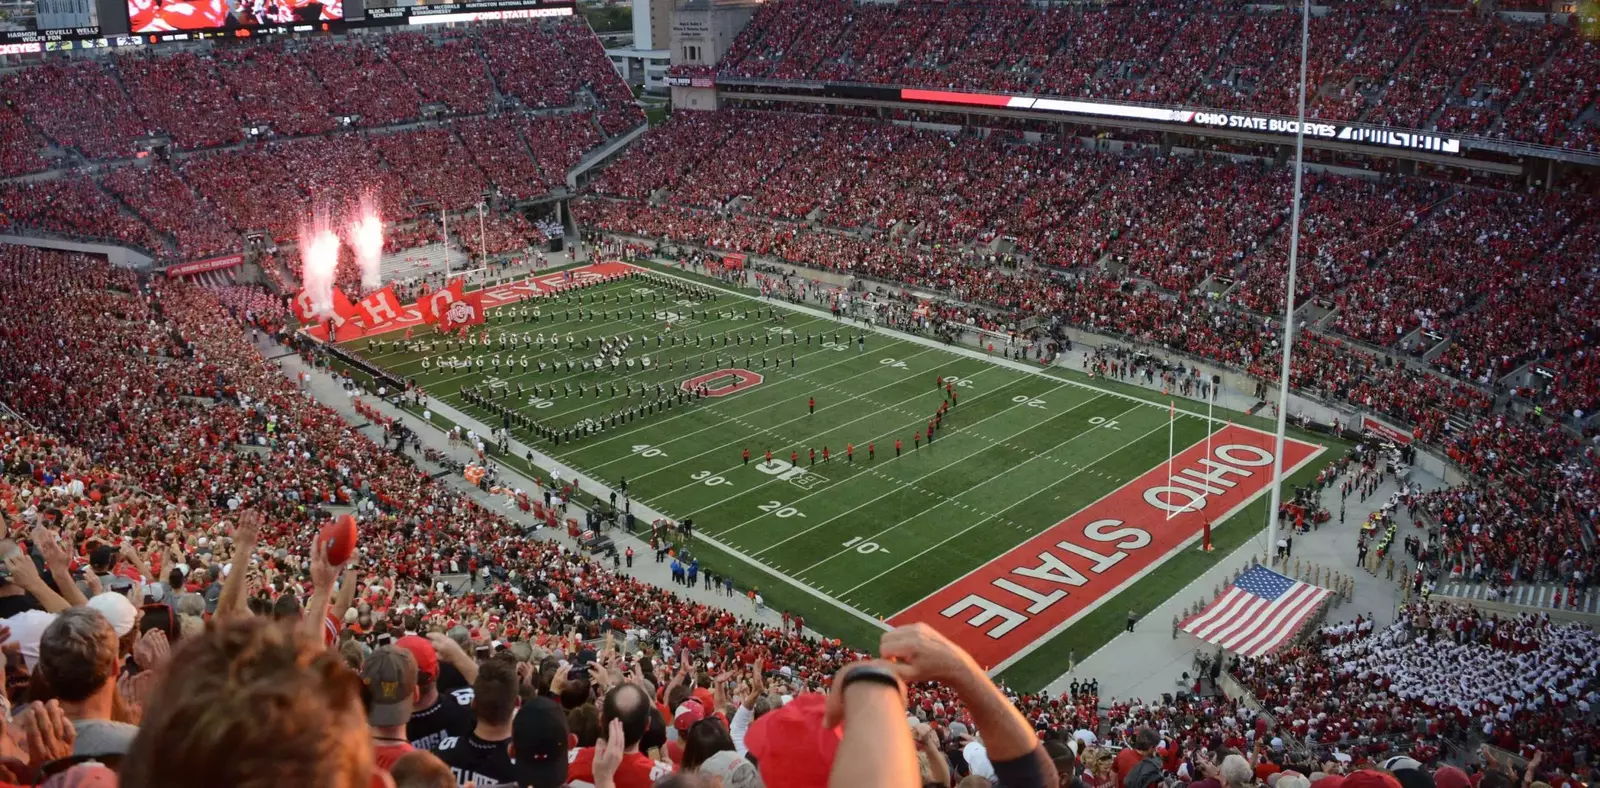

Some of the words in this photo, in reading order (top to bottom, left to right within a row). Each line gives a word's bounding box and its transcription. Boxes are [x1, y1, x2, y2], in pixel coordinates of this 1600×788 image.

[503, 10, 527, 19] STATE
[530, 8, 572, 18] BUCKEYES
[1194, 112, 1228, 126] OHIO
[1229, 115, 1267, 130] STATE
[361, 292, 396, 324] H
[880, 357, 906, 368] 40
[943, 375, 971, 388] 30
[1012, 394, 1043, 408] 20
[1088, 416, 1117, 431] 10
[632, 444, 662, 458] 40
[691, 470, 726, 486] 30
[1142, 443, 1275, 514] OHIO
[758, 500, 798, 518] 20
[842, 536, 880, 554] 10
[938, 518, 1153, 639] STATE
